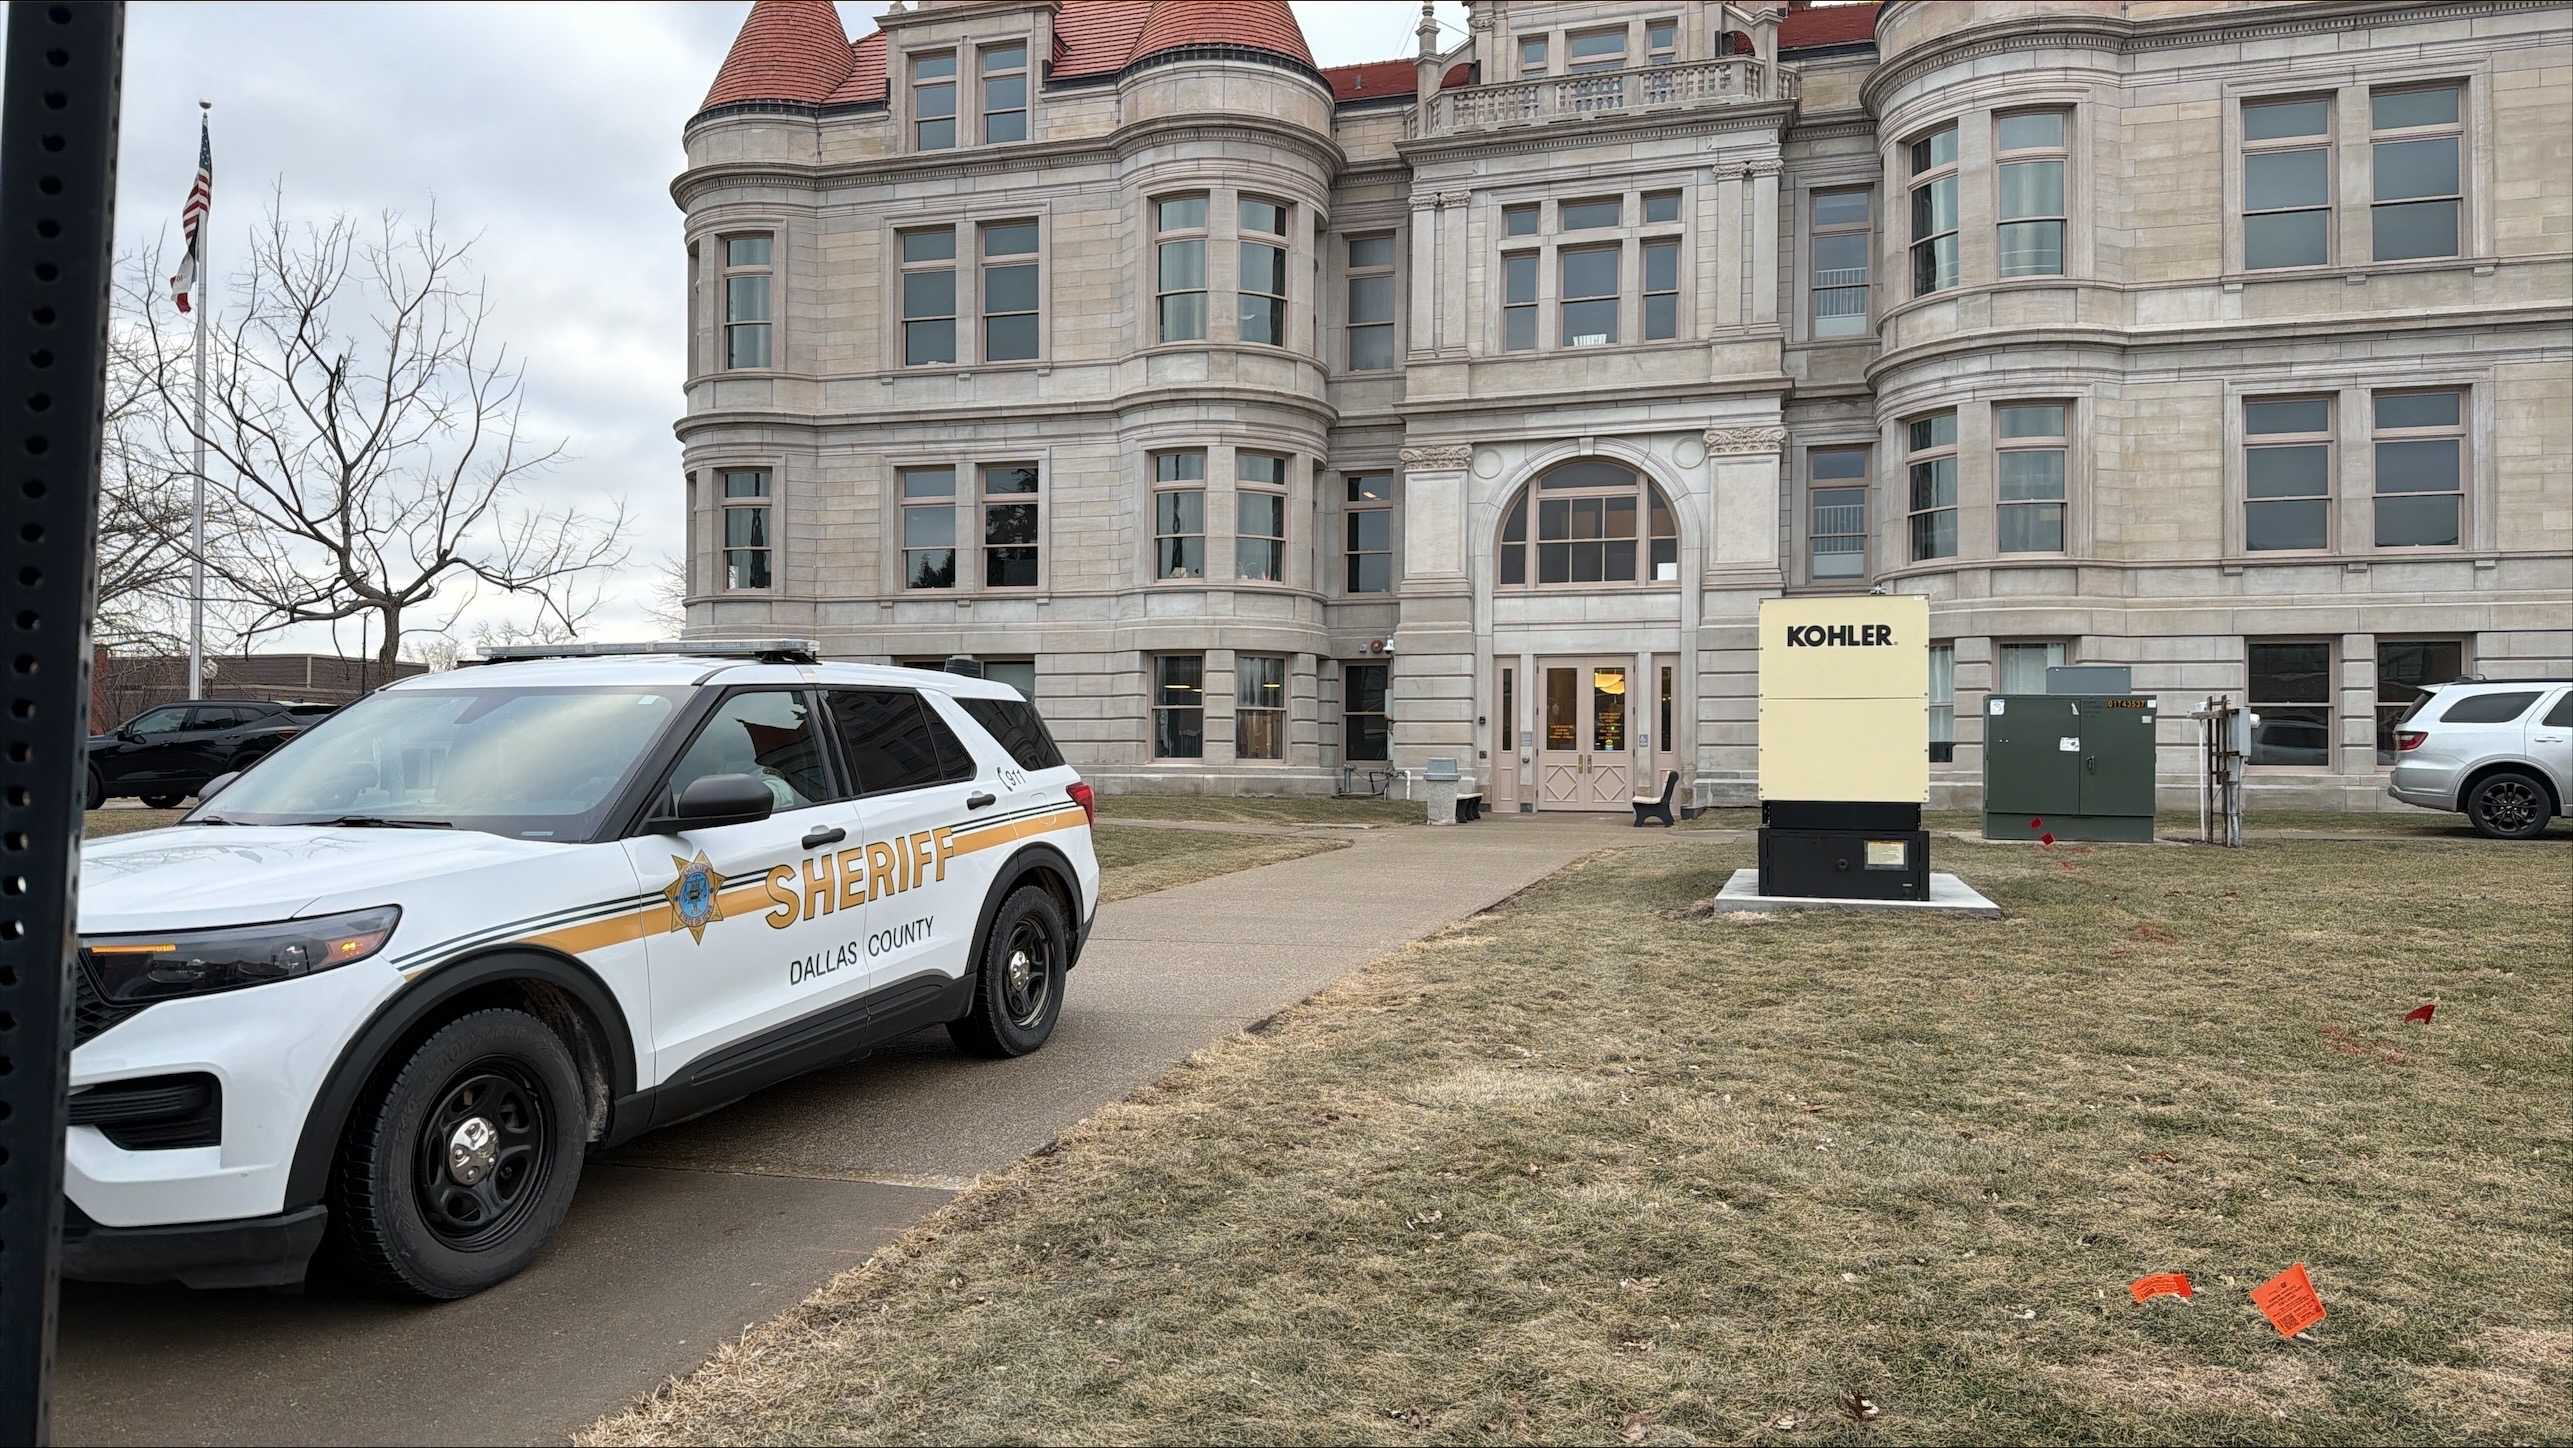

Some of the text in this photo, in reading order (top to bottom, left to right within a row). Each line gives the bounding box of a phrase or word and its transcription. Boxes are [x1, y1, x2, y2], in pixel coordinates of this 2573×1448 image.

[1787, 624, 1893, 647] KOHLER
[1005, 769, 1026, 786] 911
[765, 825, 954, 930] SHERIFF
[790, 915, 934, 986] DALLAS COUNTY
